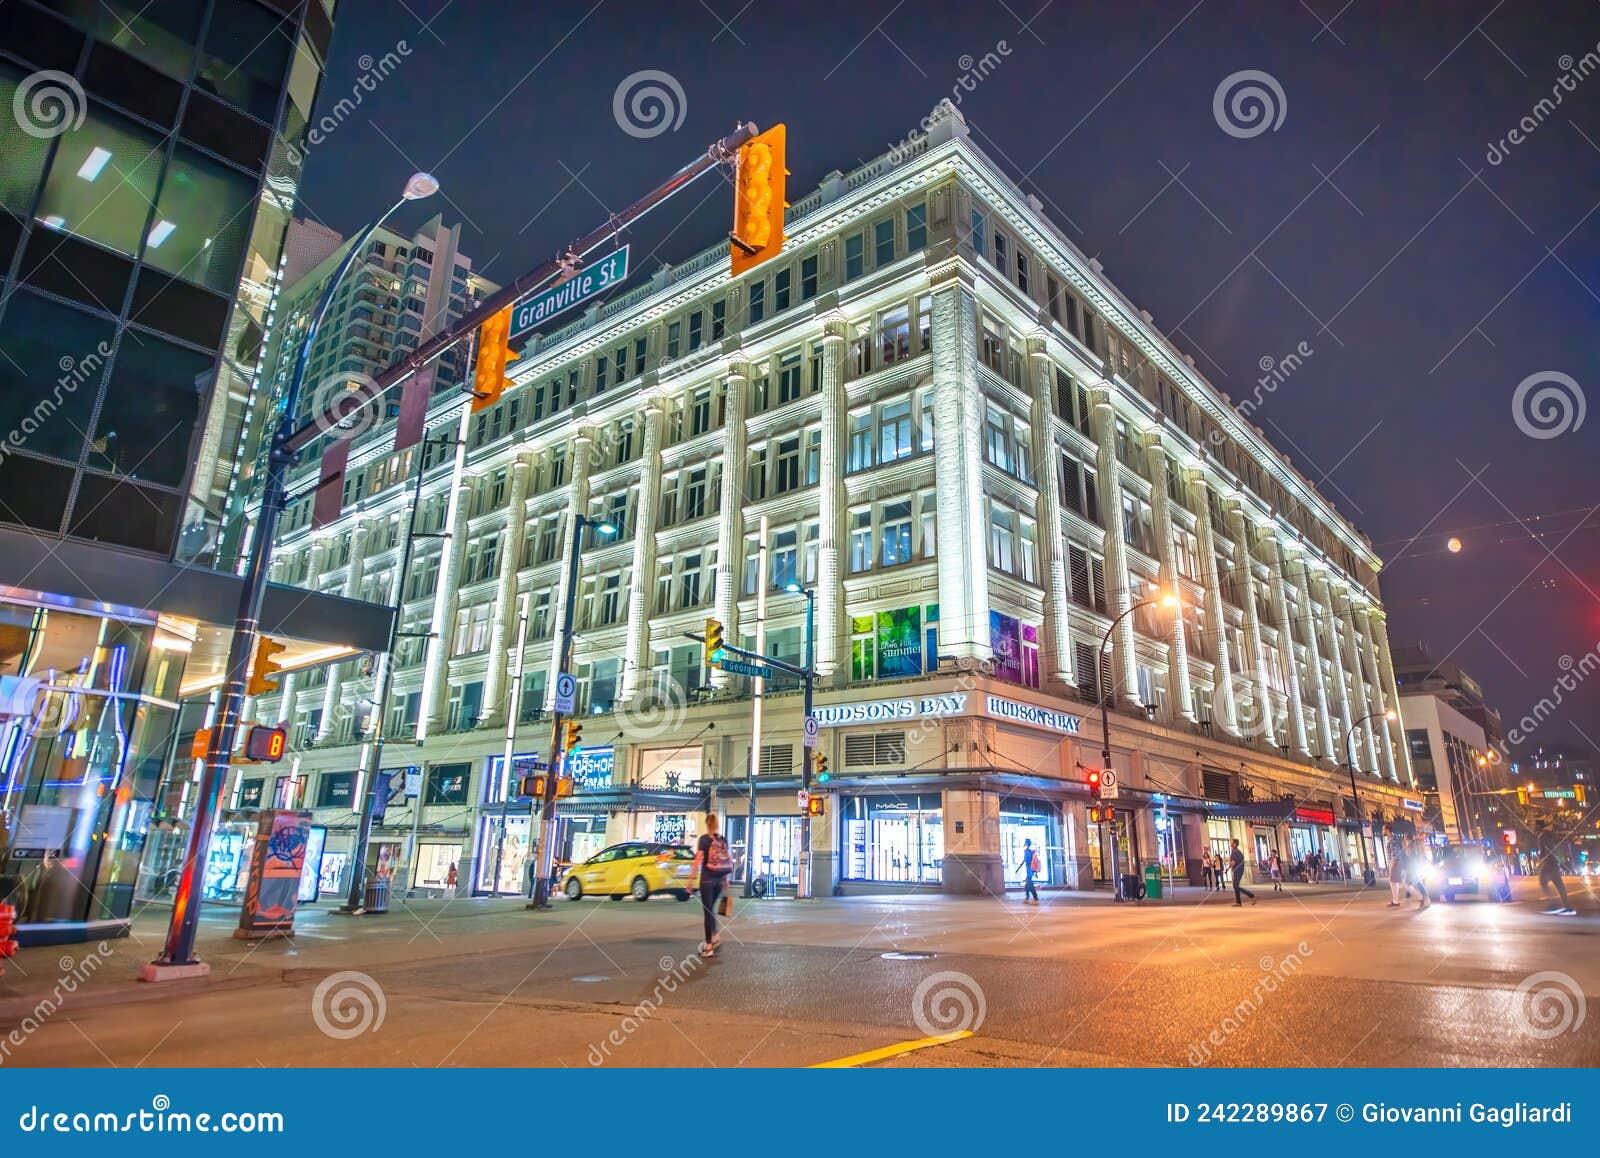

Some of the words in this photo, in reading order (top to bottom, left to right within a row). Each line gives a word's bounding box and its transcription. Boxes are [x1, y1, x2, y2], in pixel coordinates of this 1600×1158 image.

[519, 276, 592, 328] Granville
[600, 259, 616, 285] St
[812, 700, 912, 722] HUDSON'S
[919, 695, 966, 714] BAY
[990, 698, 1055, 726] HUDSON'S
[1057, 714, 1080, 732] BAY
[270, 734, 283, 757] 8
